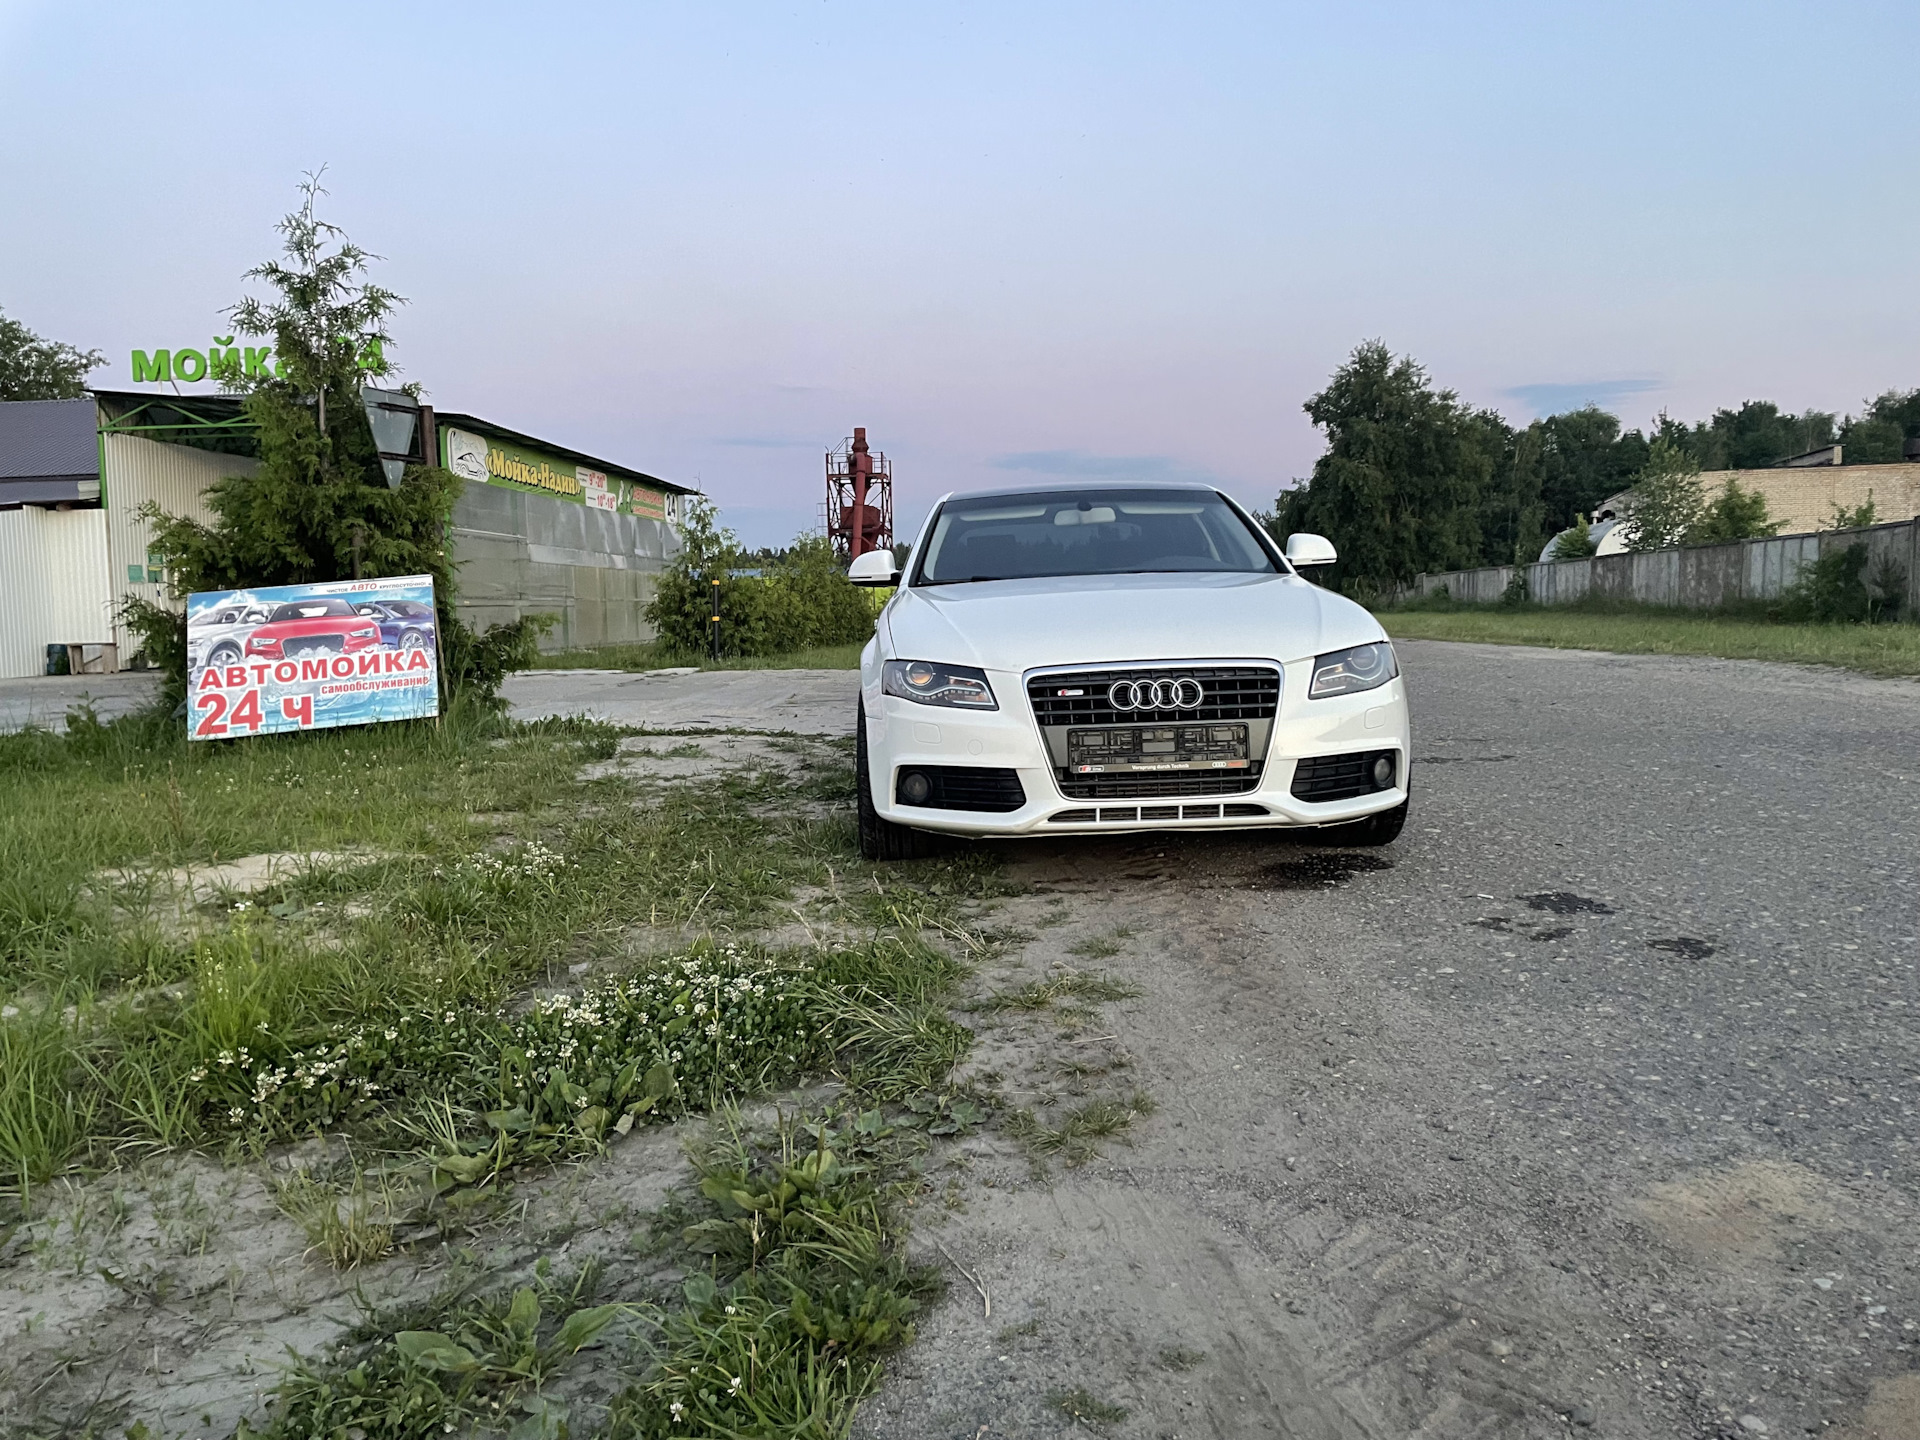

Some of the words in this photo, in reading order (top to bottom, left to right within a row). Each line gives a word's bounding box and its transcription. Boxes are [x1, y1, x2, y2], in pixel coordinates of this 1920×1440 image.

[485, 448, 581, 496] «Мойка-Надин»
[350, 583, 377, 591] АВТО
[199, 648, 430, 690] АВТОМОЙКА
[321, 675, 430, 695] самообслуживание
[196, 690, 263, 736] 24
